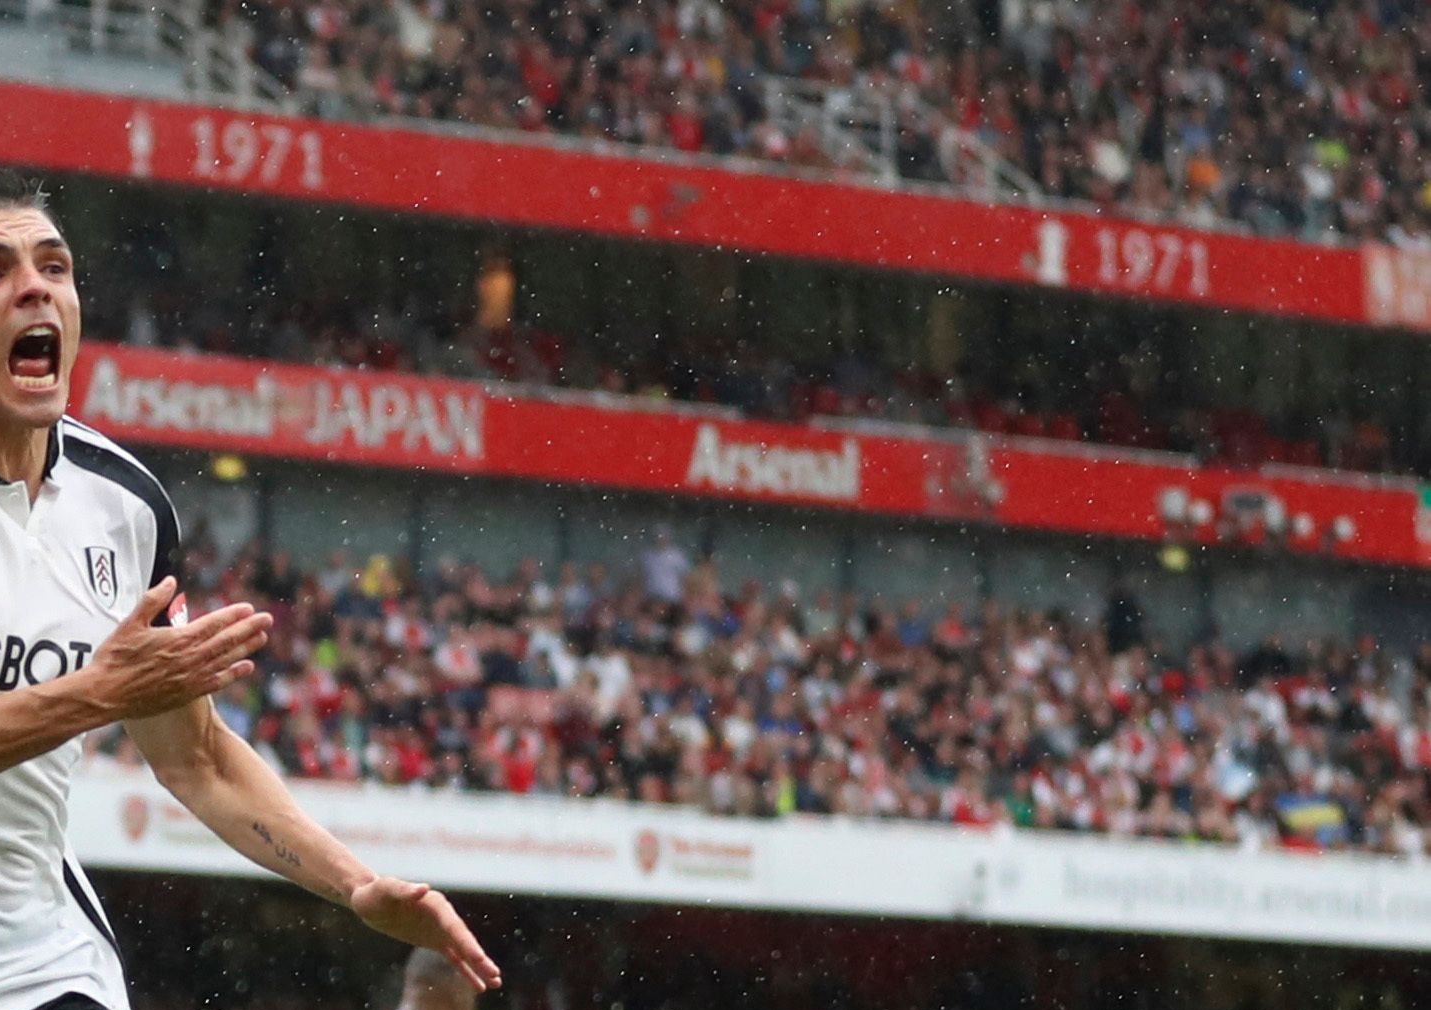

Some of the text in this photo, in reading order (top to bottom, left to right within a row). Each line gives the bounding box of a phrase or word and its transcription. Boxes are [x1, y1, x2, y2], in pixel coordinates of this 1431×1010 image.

[190, 115, 323, 188] 1971
[1096, 229, 1210, 297] 1971
[83, 357, 485, 459] Arsenal JAPAN
[687, 424, 859, 499] Arsenal
